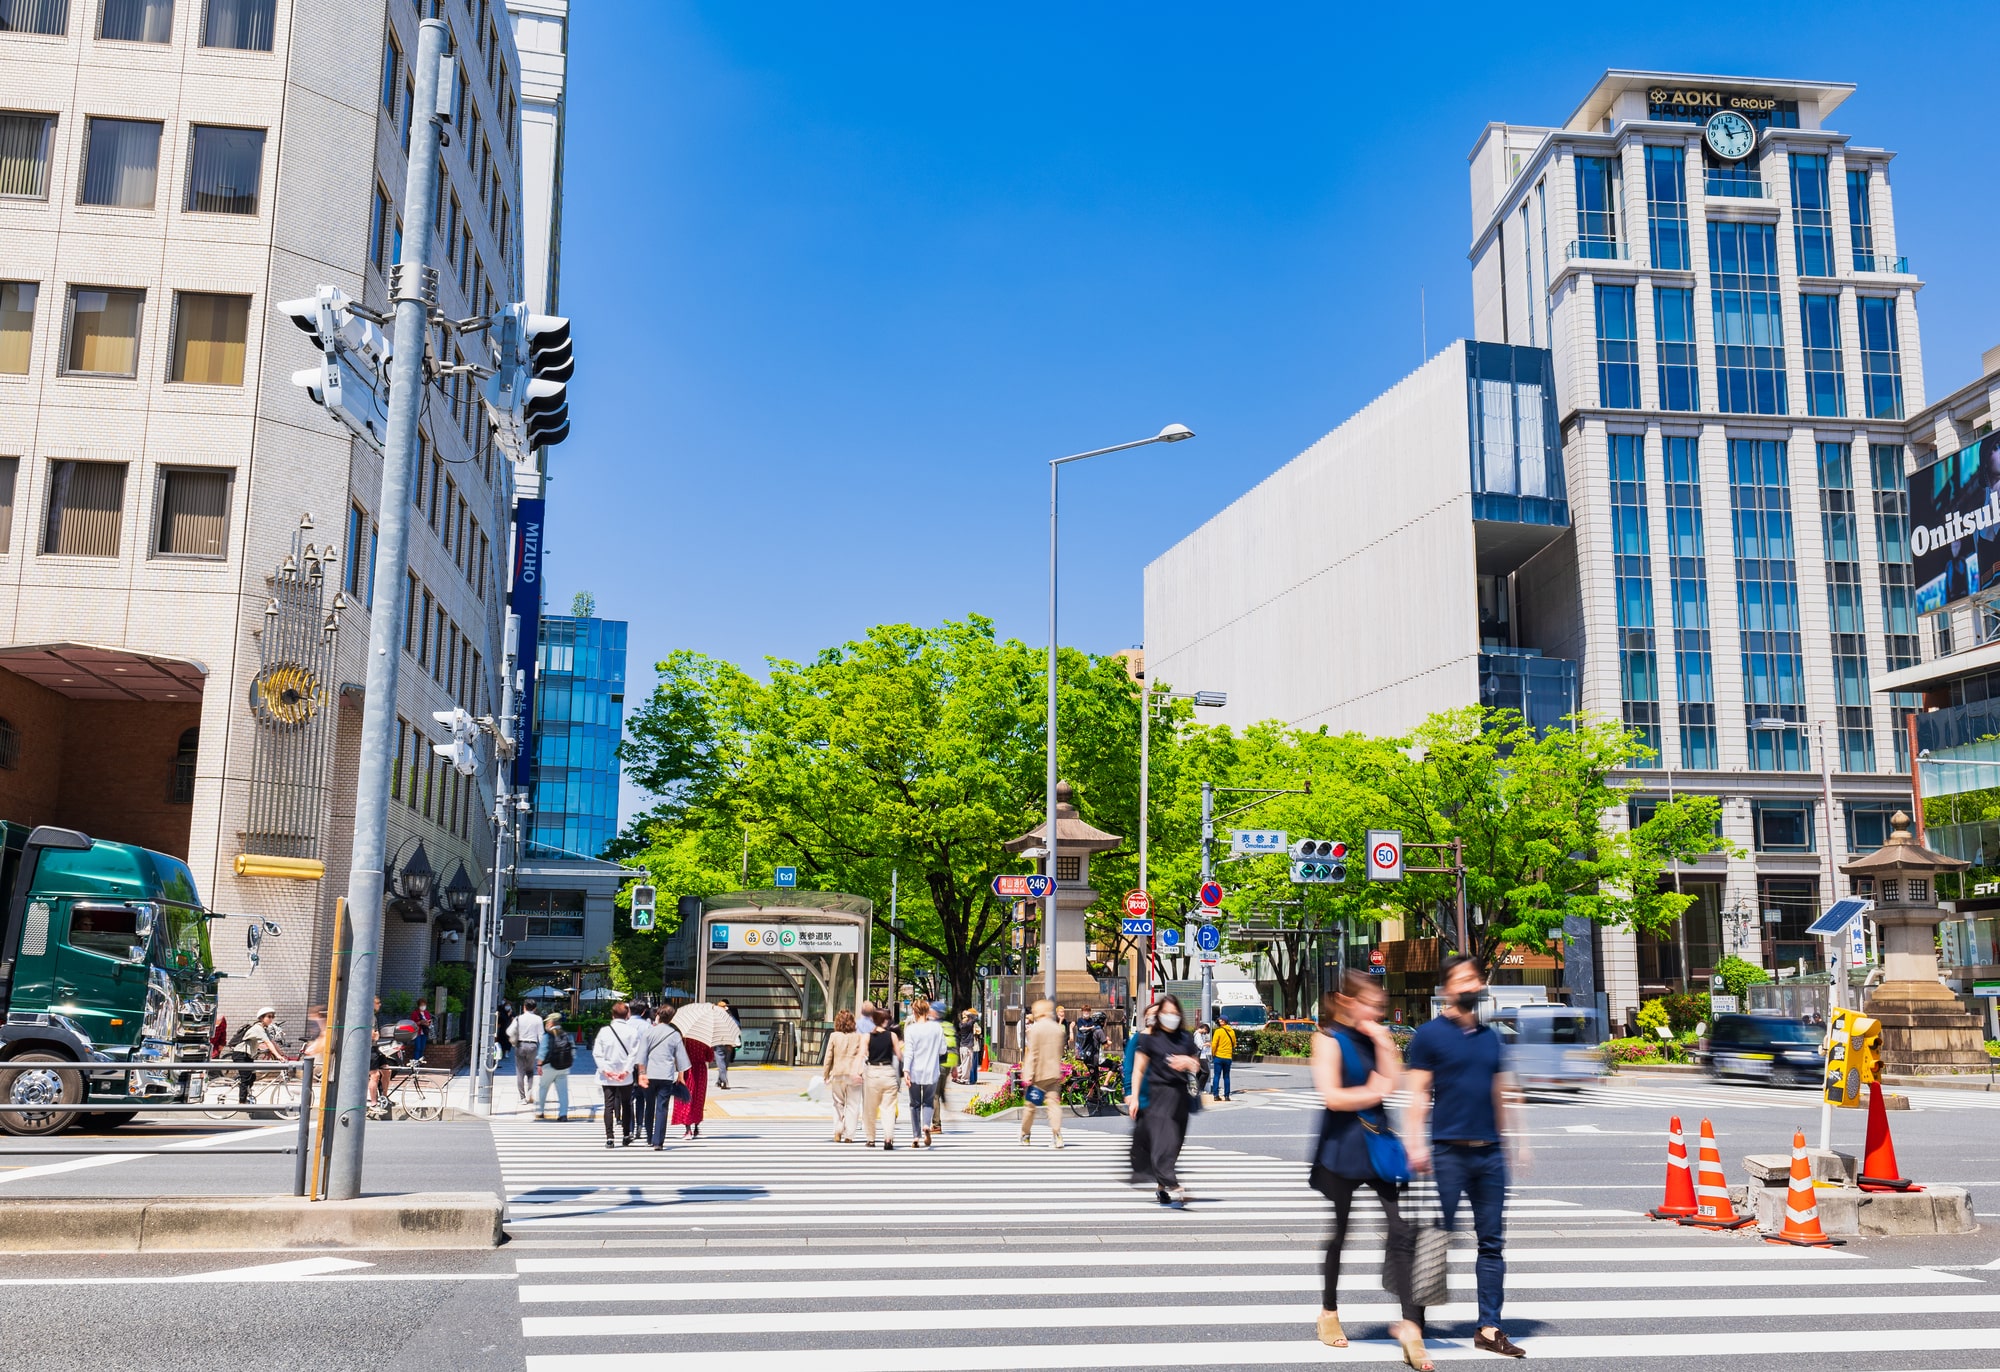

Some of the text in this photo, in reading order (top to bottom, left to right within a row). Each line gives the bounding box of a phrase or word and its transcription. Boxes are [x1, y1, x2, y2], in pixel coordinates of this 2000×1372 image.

[1671, 90, 1776, 109] AOKI GROUP
[523, 522, 540, 583] MIZUHO
[1241, 834, 1279, 844] 表参道
[1378, 850, 1393, 862] 50
[1029, 879, 1045, 889] 246
[798, 931, 832, 940] 表参道駅
